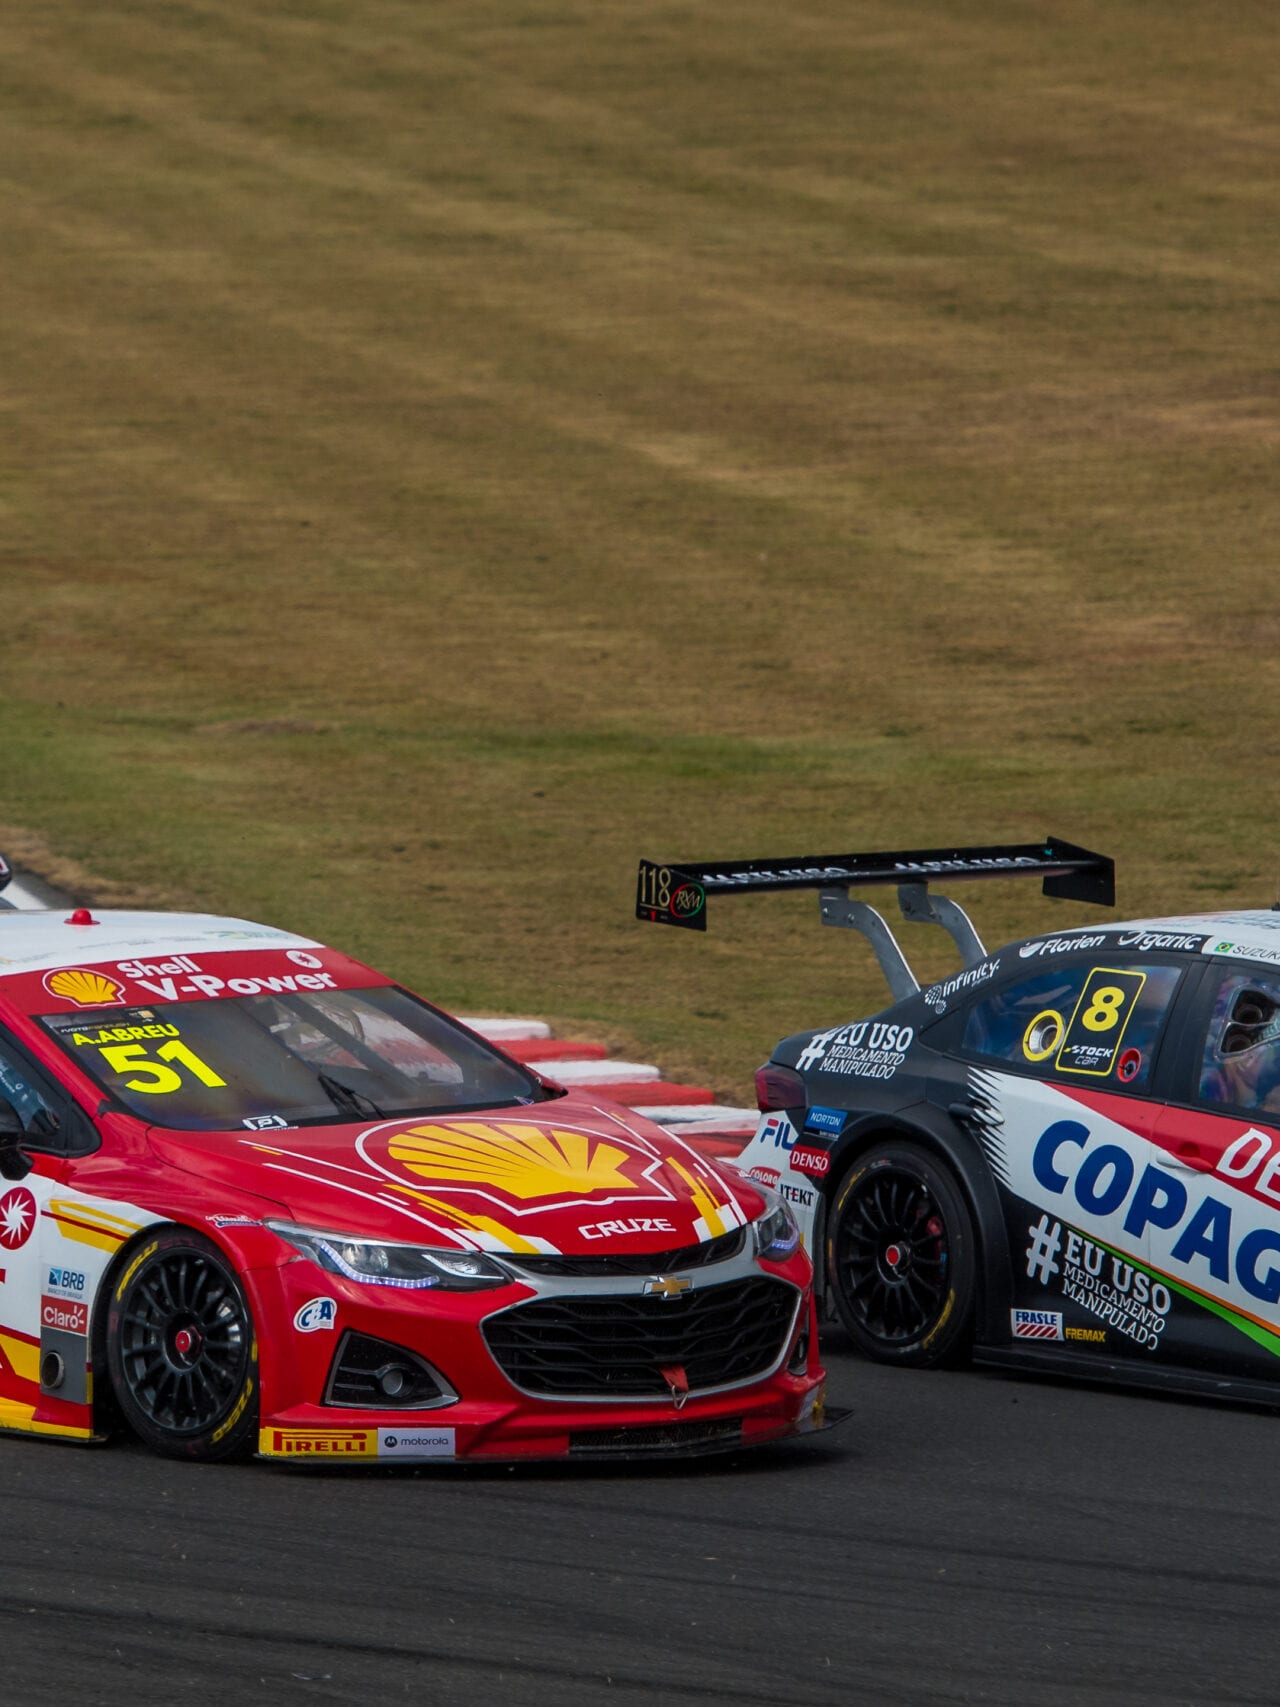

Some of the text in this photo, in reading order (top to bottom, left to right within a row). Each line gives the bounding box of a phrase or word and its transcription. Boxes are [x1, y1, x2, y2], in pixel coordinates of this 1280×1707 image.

[639, 865, 671, 908] 118
[1038, 934, 1107, 957] Florien
[116, 956, 202, 979] Shell
[135, 971, 338, 1001] V-Power
[1082, 986, 1125, 1032] 8
[73, 1023, 180, 1046] A.ABREU
[868, 1022, 914, 1052] USO
[826, 1045, 905, 1066] MEDICAMENTO
[1071, 1045, 1114, 1058] STOCK
[98, 1039, 227, 1094] 51
[819, 1058, 896, 1080] MANIPULADO
[810, 1112, 841, 1127] NORTON
[791, 1151, 829, 1171] DENSO
[1032, 1119, 1280, 1304] COPAG
[578, 1218, 677, 1240] CRUZE
[62, 1270, 85, 1291] BRB
[1112, 1256, 1172, 1315] USO
[1063, 1261, 1166, 1334] MEDICAMENTO
[43, 1306, 79, 1329] Claro
[1062, 1278, 1159, 1351] MANIPULADO
[1065, 1327, 1107, 1342] FREMAX
[273, 1430, 367, 1452] PIRELLI
[401, 1437, 449, 1446] motorola
